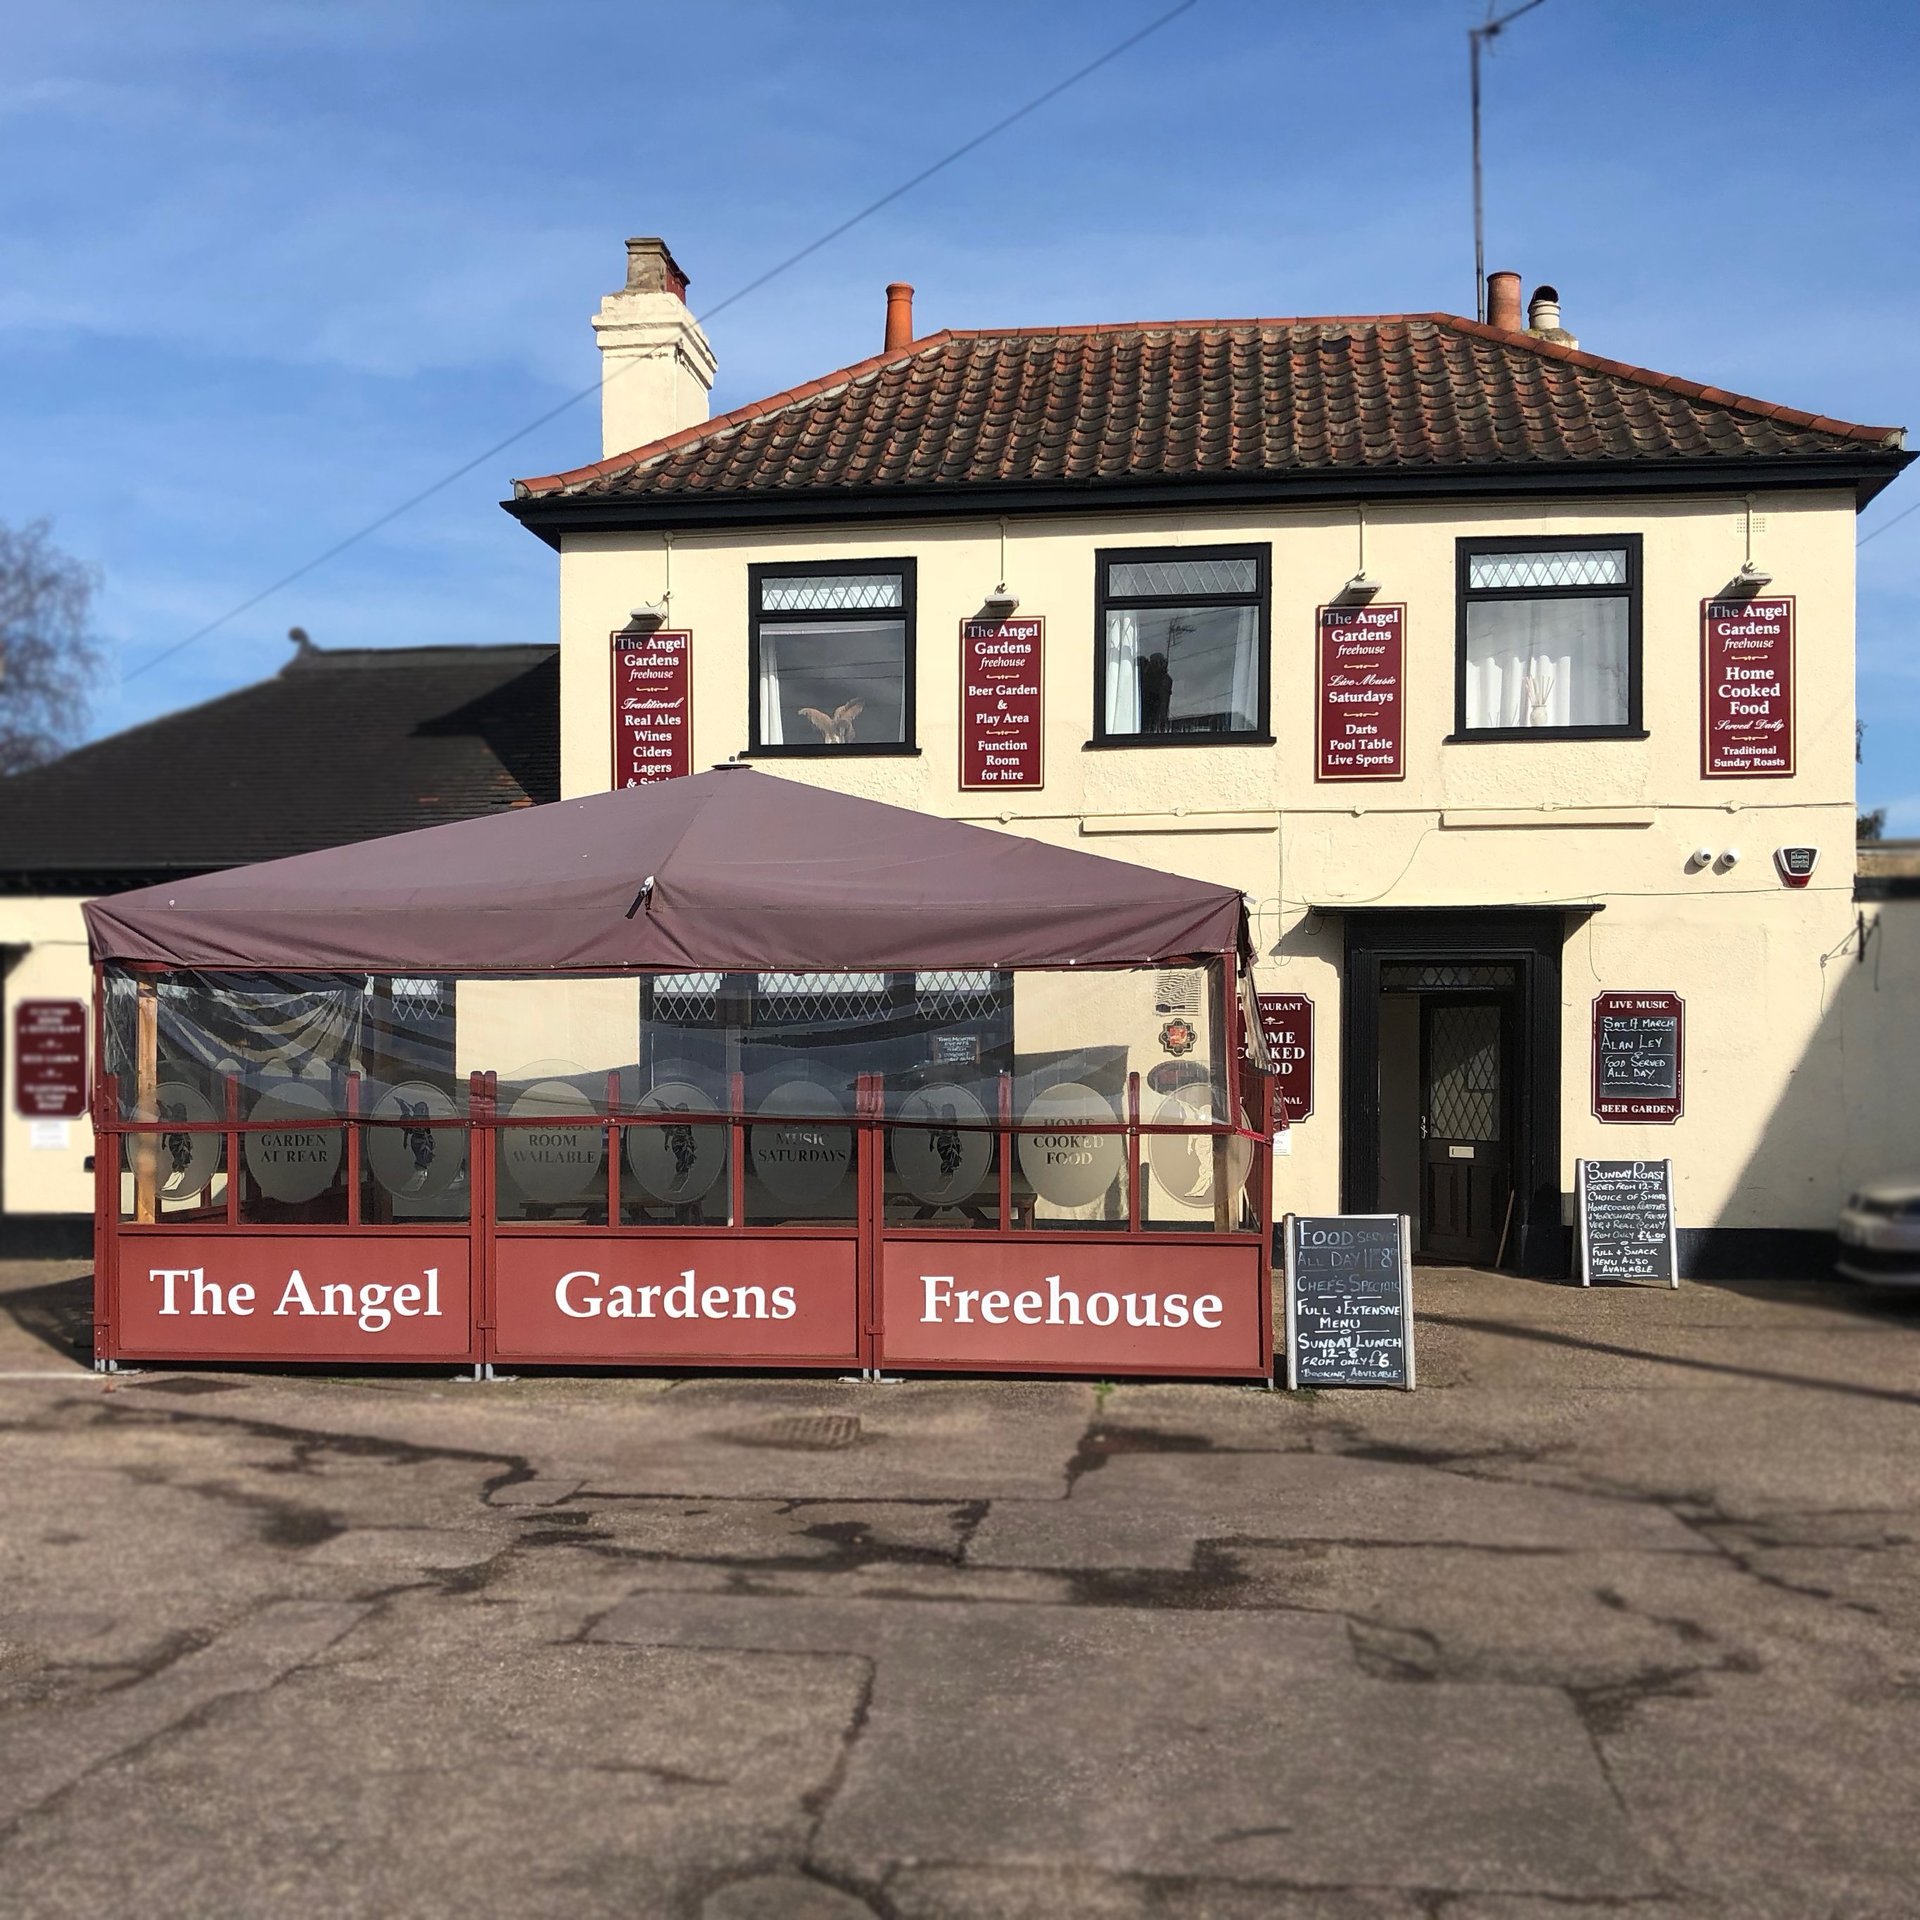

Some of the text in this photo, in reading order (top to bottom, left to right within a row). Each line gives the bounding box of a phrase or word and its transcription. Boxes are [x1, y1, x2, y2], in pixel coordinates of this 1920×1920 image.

[1324, 610, 1398, 627] The Angel
[1710, 604, 1788, 620] The Angel
[968, 624, 1038, 640] The Angel
[1331, 628, 1392, 642] Gardens
[1717, 622, 1780, 636] Gardens
[618, 637, 686, 652] The Angel
[974, 642, 1032, 654] Gardens
[1722, 638, 1774, 652] freehouse
[1336, 645, 1386, 658] freehouse
[624, 654, 679, 666] Gardens
[979, 657, 1026, 670] freehouse
[628, 669, 674, 682] freehouse
[1726, 666, 1774, 680] Home
[1327, 674, 1396, 686] Live Music
[968, 684, 1038, 696] Beer Garden
[1718, 683, 1780, 698] Cooked
[621, 697, 684, 710] Traditional
[1328, 690, 1394, 705] Saturdays
[997, 700, 1008, 710] &
[1730, 701, 1770, 714] Food
[625, 714, 681, 726] Real Ales
[976, 713, 1029, 726] Play Area
[1714, 718, 1784, 732] Served Daily
[634, 730, 672, 741] Wines
[1346, 724, 1378, 734] Darts
[978, 740, 1028, 751] Function
[1330, 738, 1392, 750] Pool Table
[1722, 746, 1776, 755] Traditional
[633, 746, 672, 758] Ciders
[986, 755, 1020, 766] Room
[1328, 754, 1394, 767] Live Sports
[1714, 758, 1785, 770] Sunday Roasts
[633, 762, 672, 776] Lagers
[981, 770, 1024, 780] for hire
[626, 778, 637, 788] &
[1238, 1002, 1302, 1011] RAURANT
[1631, 1105, 1675, 1113] GARDEN
[261, 1134, 327, 1146] GARDEN
[528, 1134, 577, 1146] ROOM
[776, 1132, 830, 1146] MUSIC
[1033, 1136, 1104, 1148] COOKED
[261, 1150, 328, 1162] AT REAR
[513, 1151, 596, 1164] AVAILABLE
[758, 1150, 846, 1162] SATURDAYS
[1046, 1152, 1093, 1165] FOOD
[149, 1267, 443, 1332] The Angel
[554, 1270, 797, 1320] Gardens
[919, 1274, 1224, 1329] Freehouse
